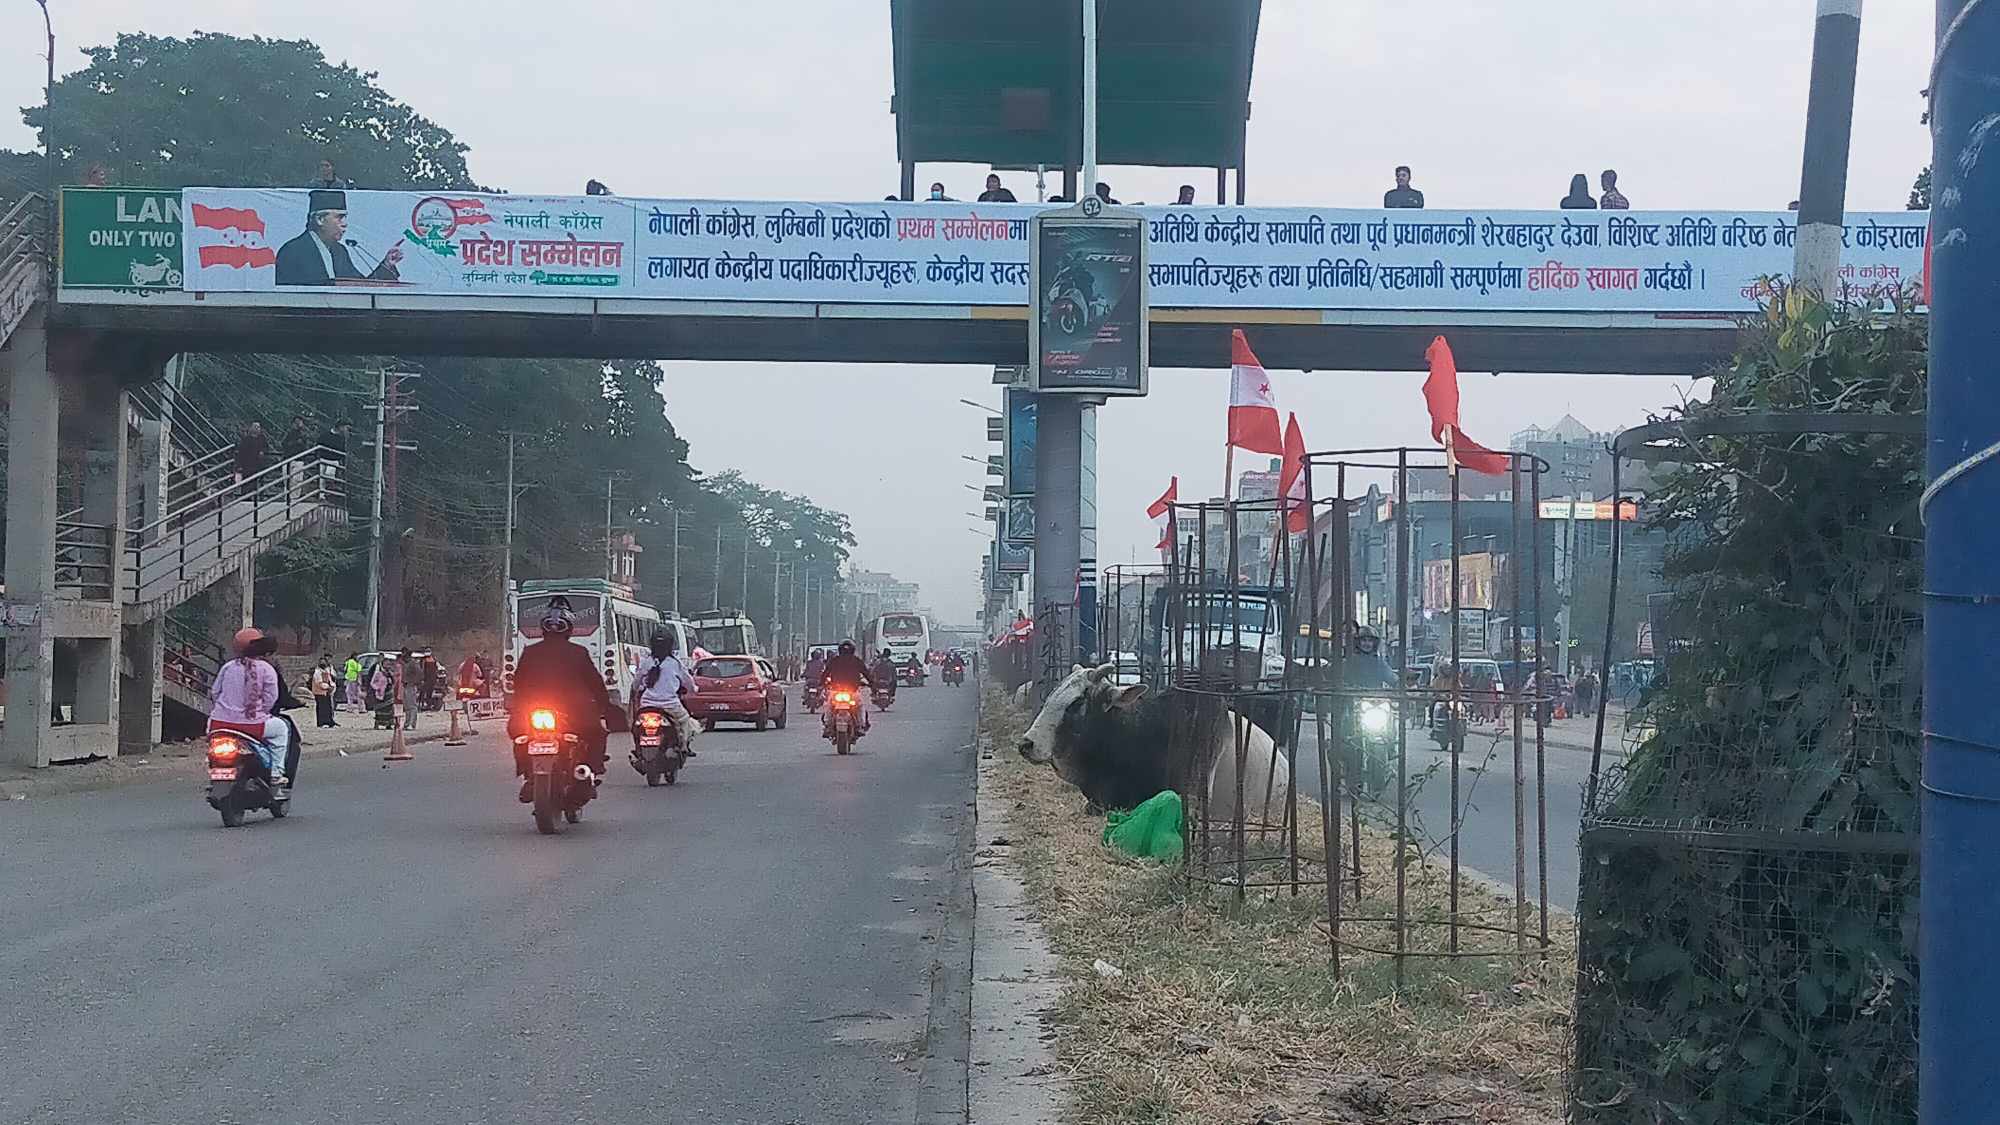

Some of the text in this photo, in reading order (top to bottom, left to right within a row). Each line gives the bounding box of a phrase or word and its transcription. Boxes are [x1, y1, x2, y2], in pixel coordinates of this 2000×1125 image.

[116, 196, 182, 223] LAN
[504, 212, 551, 229] नेपाली
[648, 206, 701, 236] नेपाली
[765, 208, 826, 244] लुम्बिनी
[831, 209, 891, 241] प्रदेशको
[896, 217, 936, 242] प्रथम
[941, 211, 1028, 242] सम्मेलनमा
[1084, 200, 1100, 214] 52
[90, 230, 175, 247] ONLY TWO
[460, 231, 624, 269] प्रदेश सम्मेलन
[1149, 213, 1200, 243] अतिथि
[1204, 214, 1260, 246] केन्द्रीय
[1266, 214, 1326, 245] सभापति
[1330, 223, 1362, 245] तथा
[1367, 217, 1388, 251] पूर्व
[1393, 217, 1476, 248] प्रधानमन्त्री
[1481, 216, 1556, 253] शेरबहादुर
[1608, 217, 1661, 249] विशिष्ट
[1665, 217, 1717, 247] अतिथि
[1722, 217, 1768, 248] वरिष्ठ
[647, 257, 711, 280] लगायत
[715, 250, 774, 283] केन्द्रीय
[926, 253, 985, 286] केन्द्रीय
[1268, 265, 1301, 288] तथा
[1450, 261, 1523, 296] सम्पूर्णमा
[1527, 260, 1581, 292] हार्दिक
[1586, 267, 1639, 292] स्वागत
